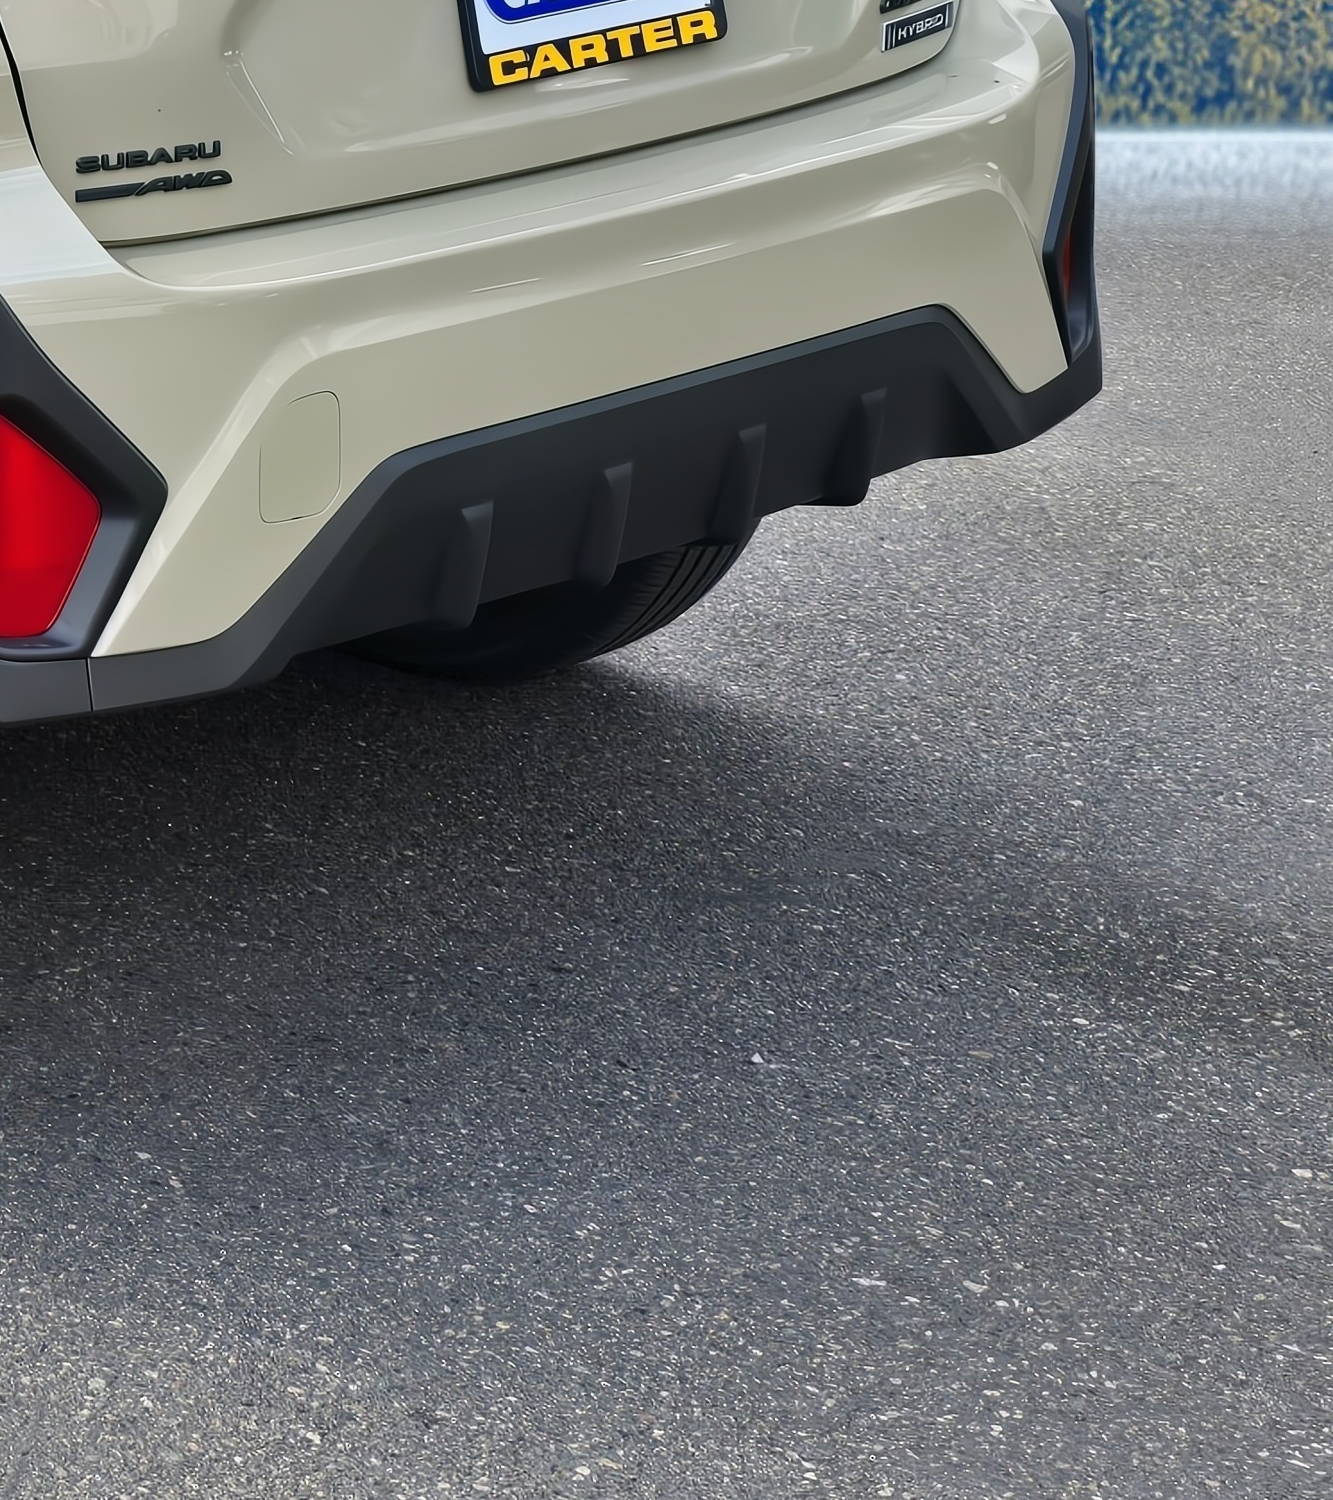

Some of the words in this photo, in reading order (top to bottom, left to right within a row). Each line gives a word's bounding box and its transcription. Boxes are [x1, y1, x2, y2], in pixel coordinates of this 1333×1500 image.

[488, 9, 718, 87] CARTER
[75, 140, 222, 174] SUBARU
[134, 169, 233, 197] AWD
